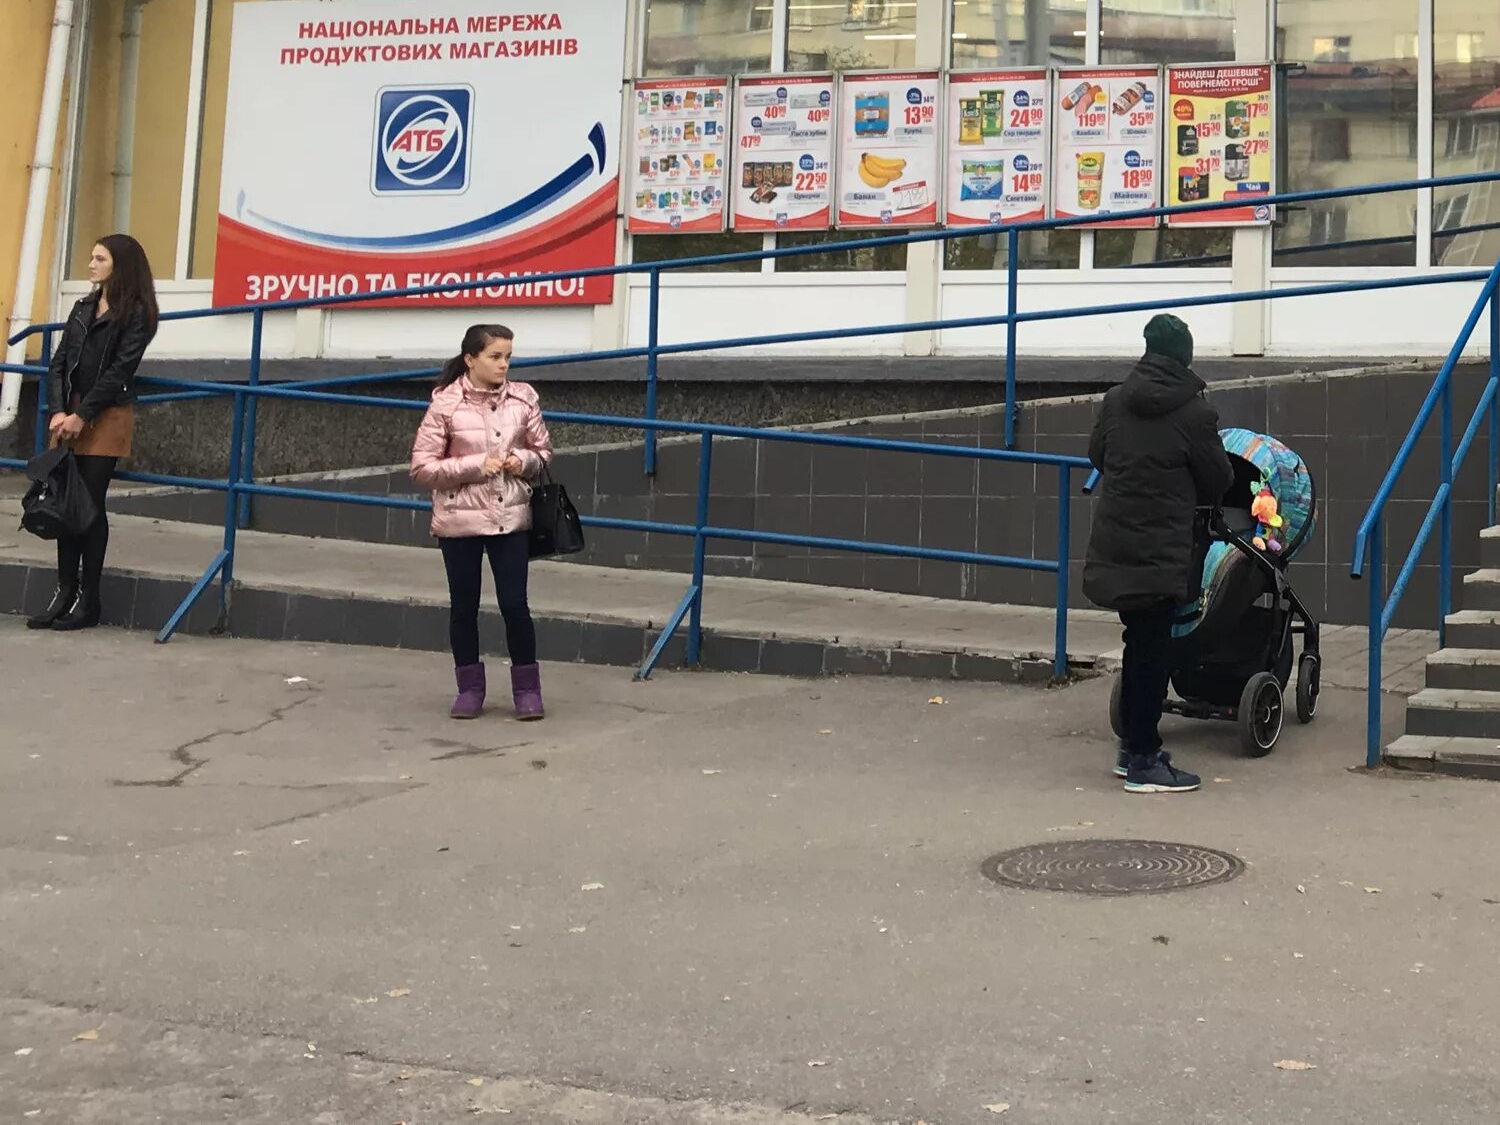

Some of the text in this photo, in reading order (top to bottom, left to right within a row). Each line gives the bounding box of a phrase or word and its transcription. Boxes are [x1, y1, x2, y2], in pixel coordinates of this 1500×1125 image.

[298, 13, 562, 40] НАЦІОНАЛЬНА МЕРЕЖА
[280, 38, 578, 66] ПРОДУКТОВИХ МАГАЗИНІВ
[1173, 69, 1216, 80] ЗНАЙДЕШ
[1178, 78, 1230, 89] ПОВЕРНЕМО
[392, 129, 446, 153] АТБ
[1114, 191, 1148, 200] Майонез
[245, 274, 359, 301] ЗРУЧНО
[365, 273, 398, 297] ТА
